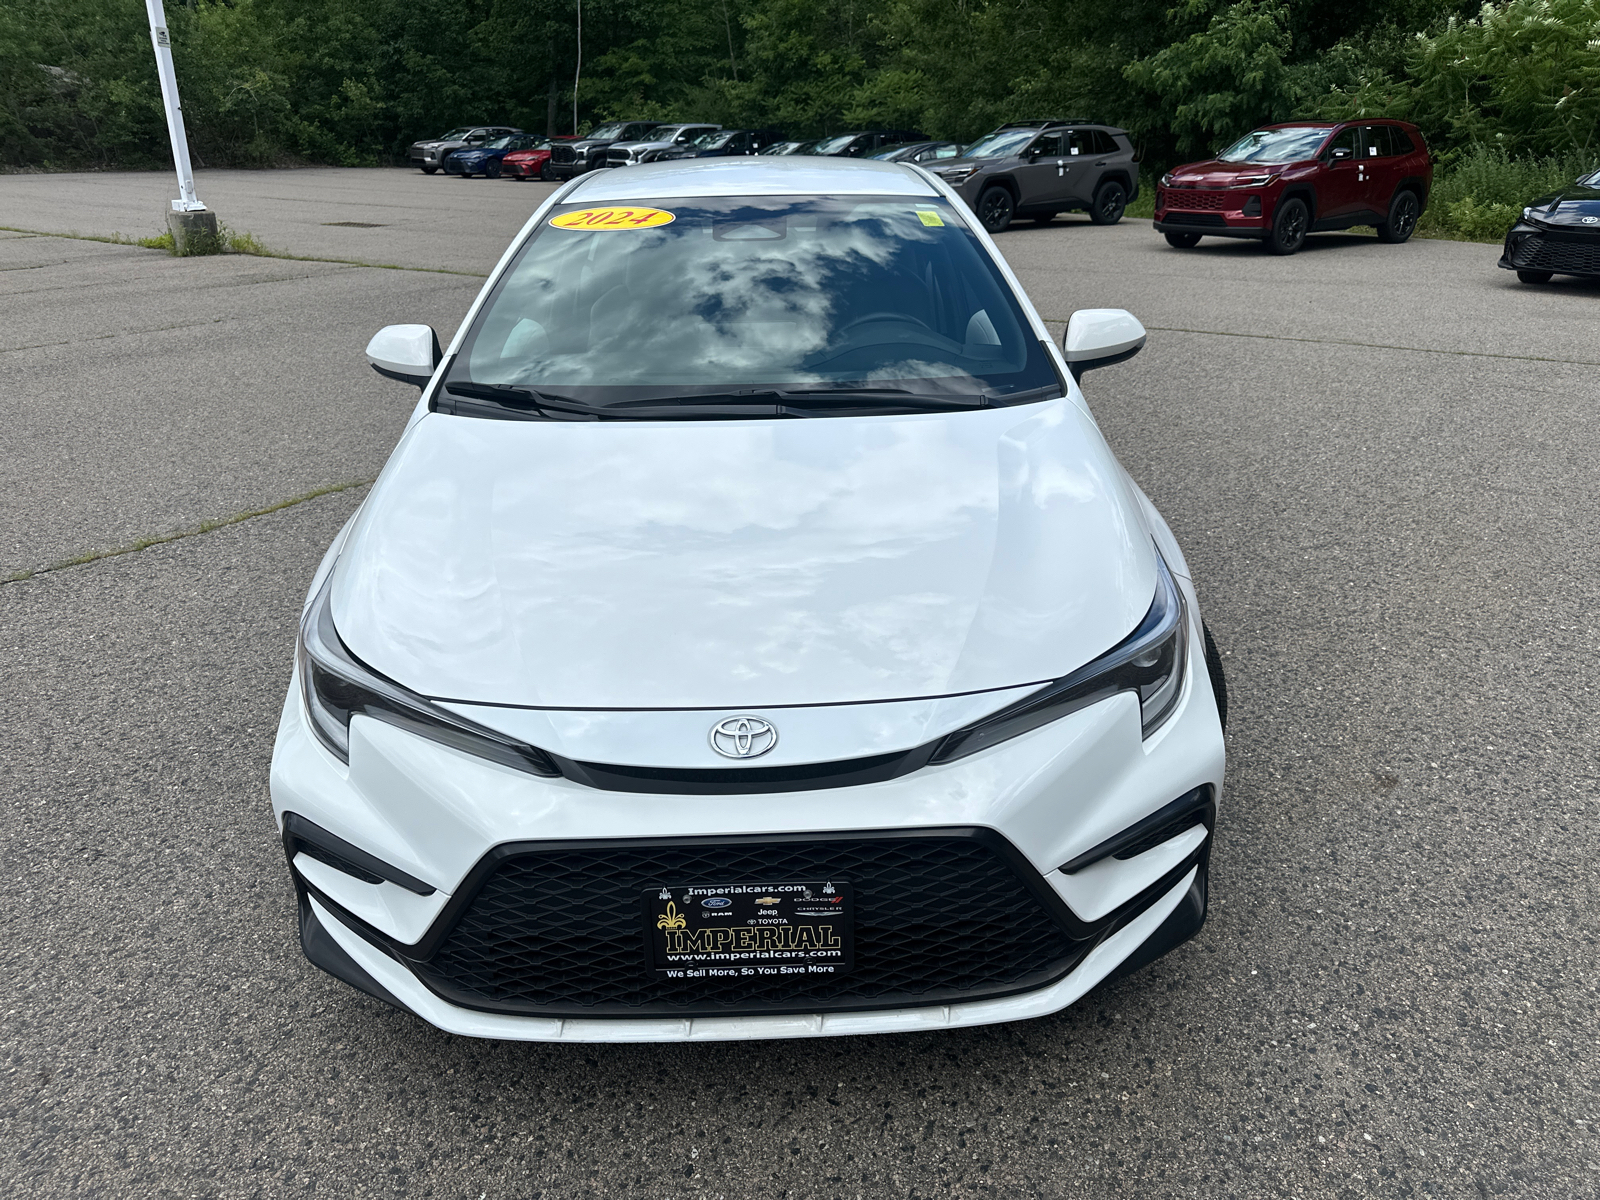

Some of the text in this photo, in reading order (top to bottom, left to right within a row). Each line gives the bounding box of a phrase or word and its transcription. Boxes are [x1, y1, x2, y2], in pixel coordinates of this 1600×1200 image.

[563, 211, 660, 226] 2024
[688, 885, 806, 896] Imperialcars.com
[758, 908, 778, 916] Jeep
[665, 925, 841, 953] IMPERIAL
[667, 950, 841, 961] www.imperialcars.com
[687, 969, 705, 977] Sell
[709, 969, 738, 977] More,
[780, 966, 805, 974] Save
[808, 965, 834, 973] More
